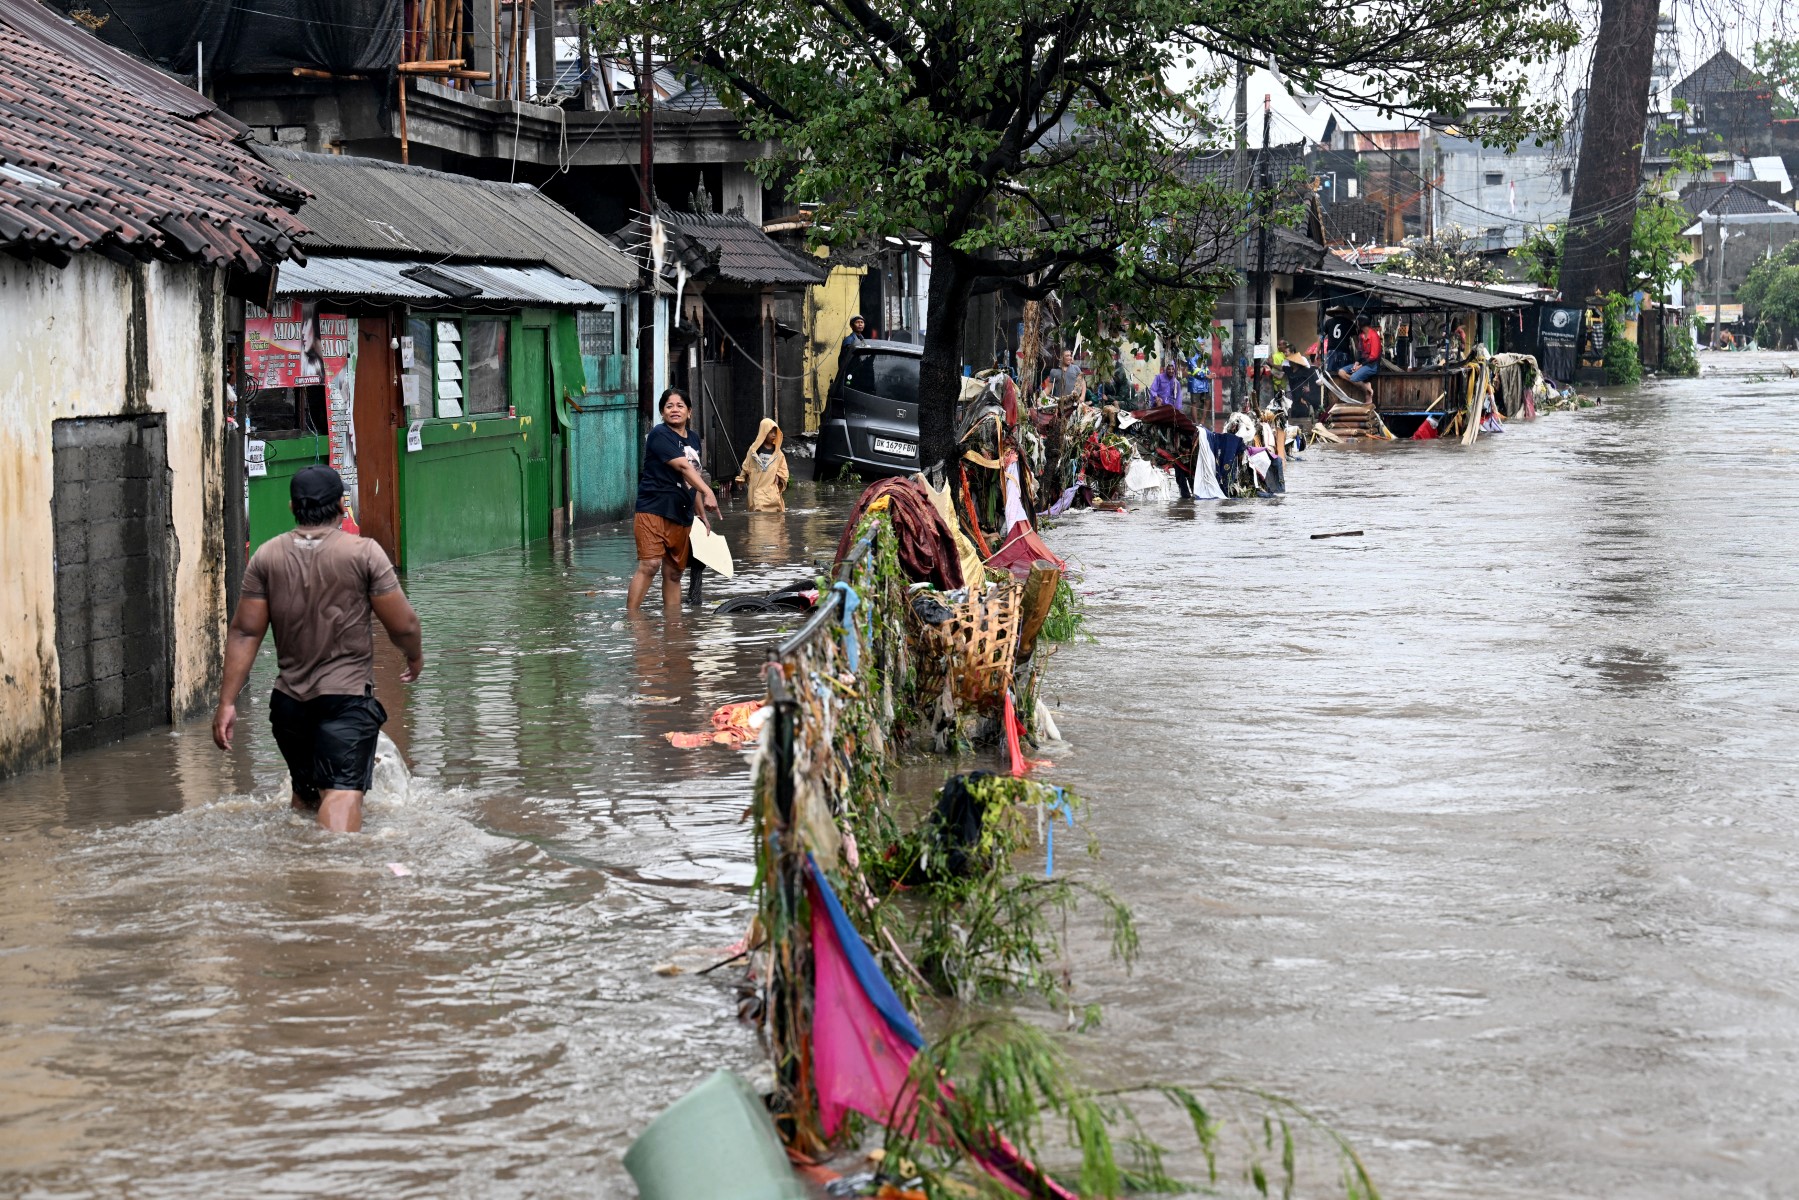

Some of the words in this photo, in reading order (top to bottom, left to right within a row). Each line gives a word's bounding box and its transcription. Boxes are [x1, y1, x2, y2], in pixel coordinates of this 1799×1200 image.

[1333, 323, 1341, 339] 6
[876, 439, 885, 447] DK
[886, 441, 903, 450] 1679
[902, 443, 916, 453] FBN
